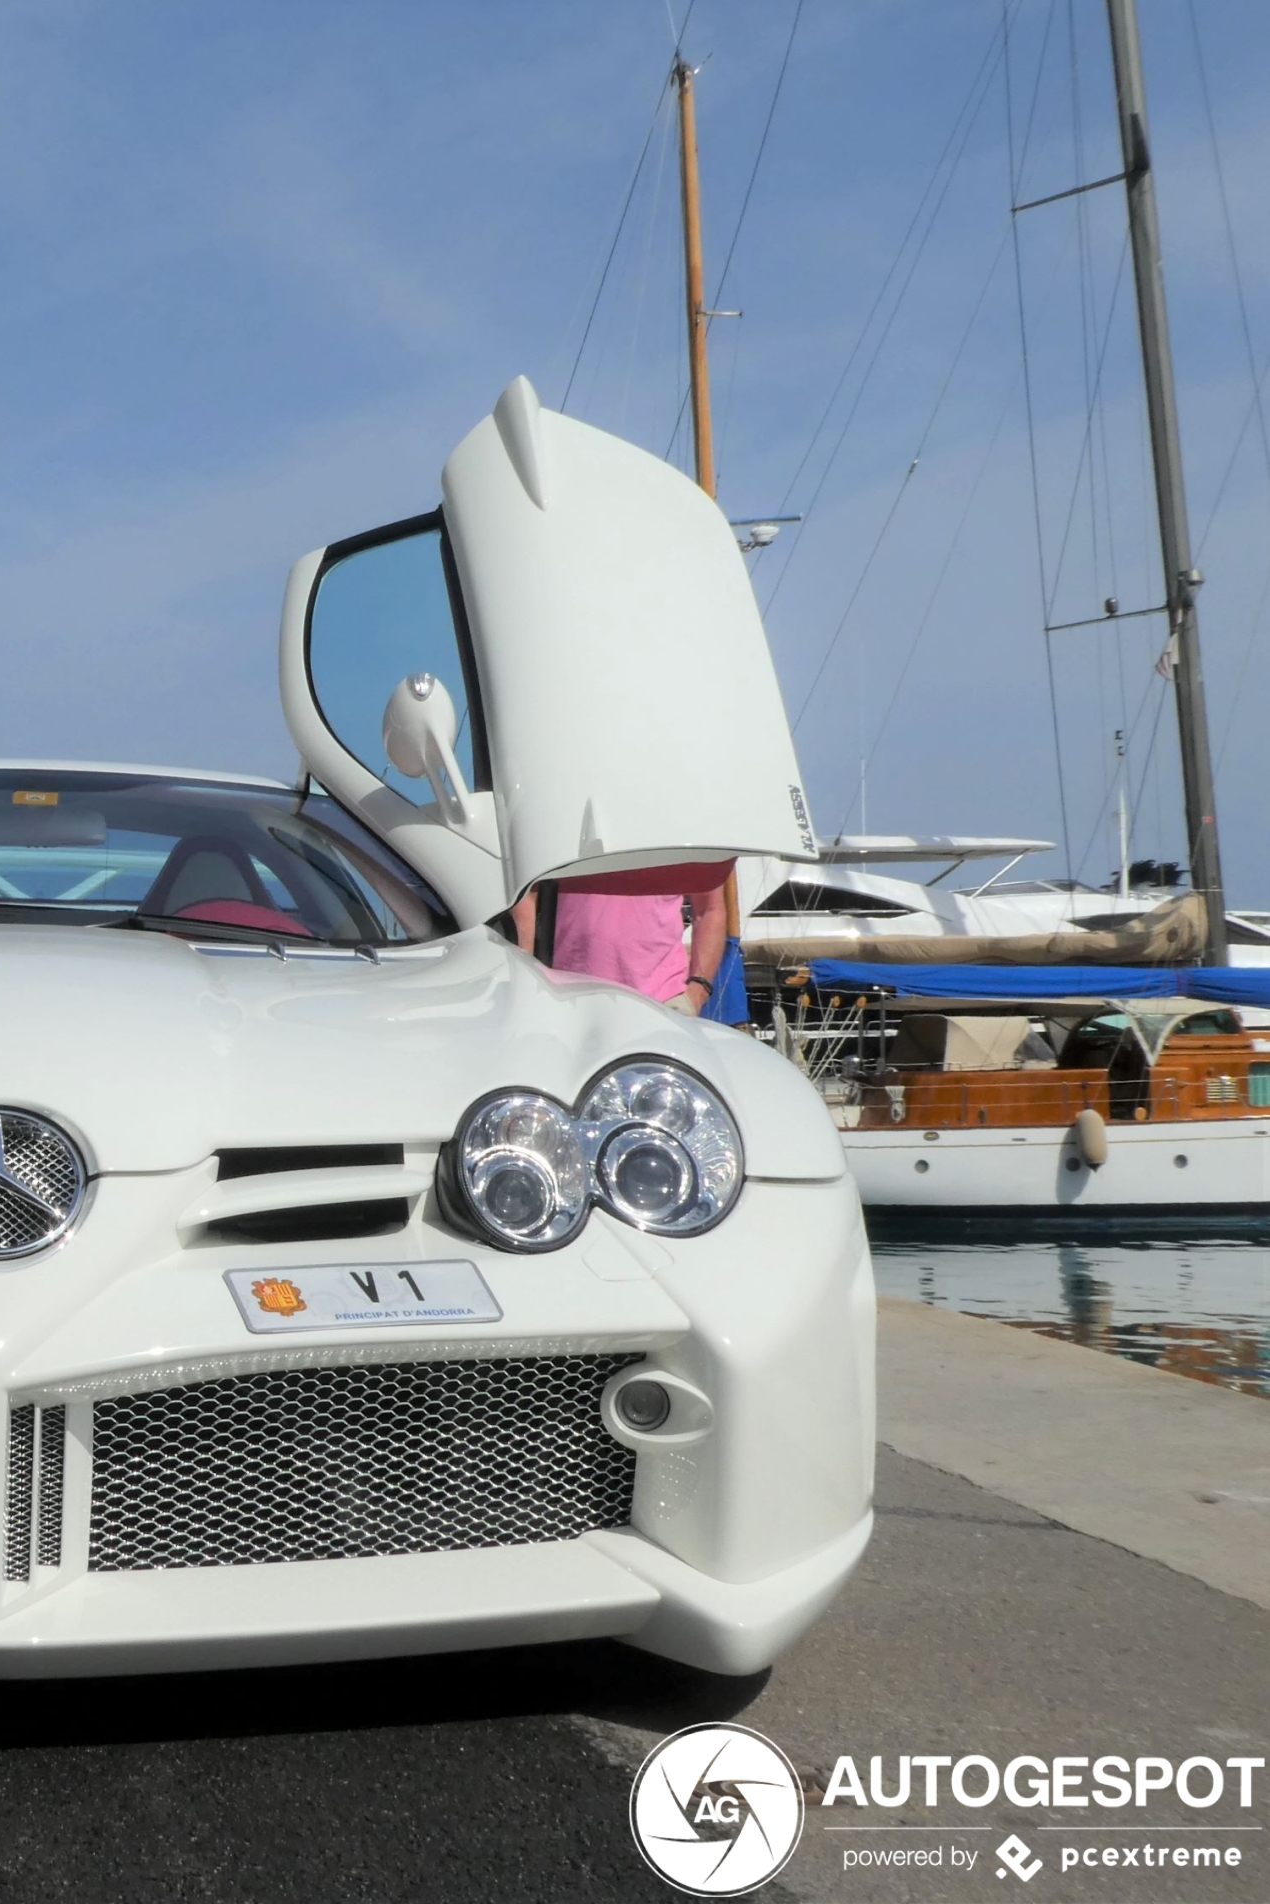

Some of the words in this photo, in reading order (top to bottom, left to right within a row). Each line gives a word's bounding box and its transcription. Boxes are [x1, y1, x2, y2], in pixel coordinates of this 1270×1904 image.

[349, 1271, 380, 1303] V
[397, 1270, 425, 1302] 1
[334, 1310, 399, 1321] PRINCIPAT
[403, 1307, 475, 1318] D'ANDORRA
